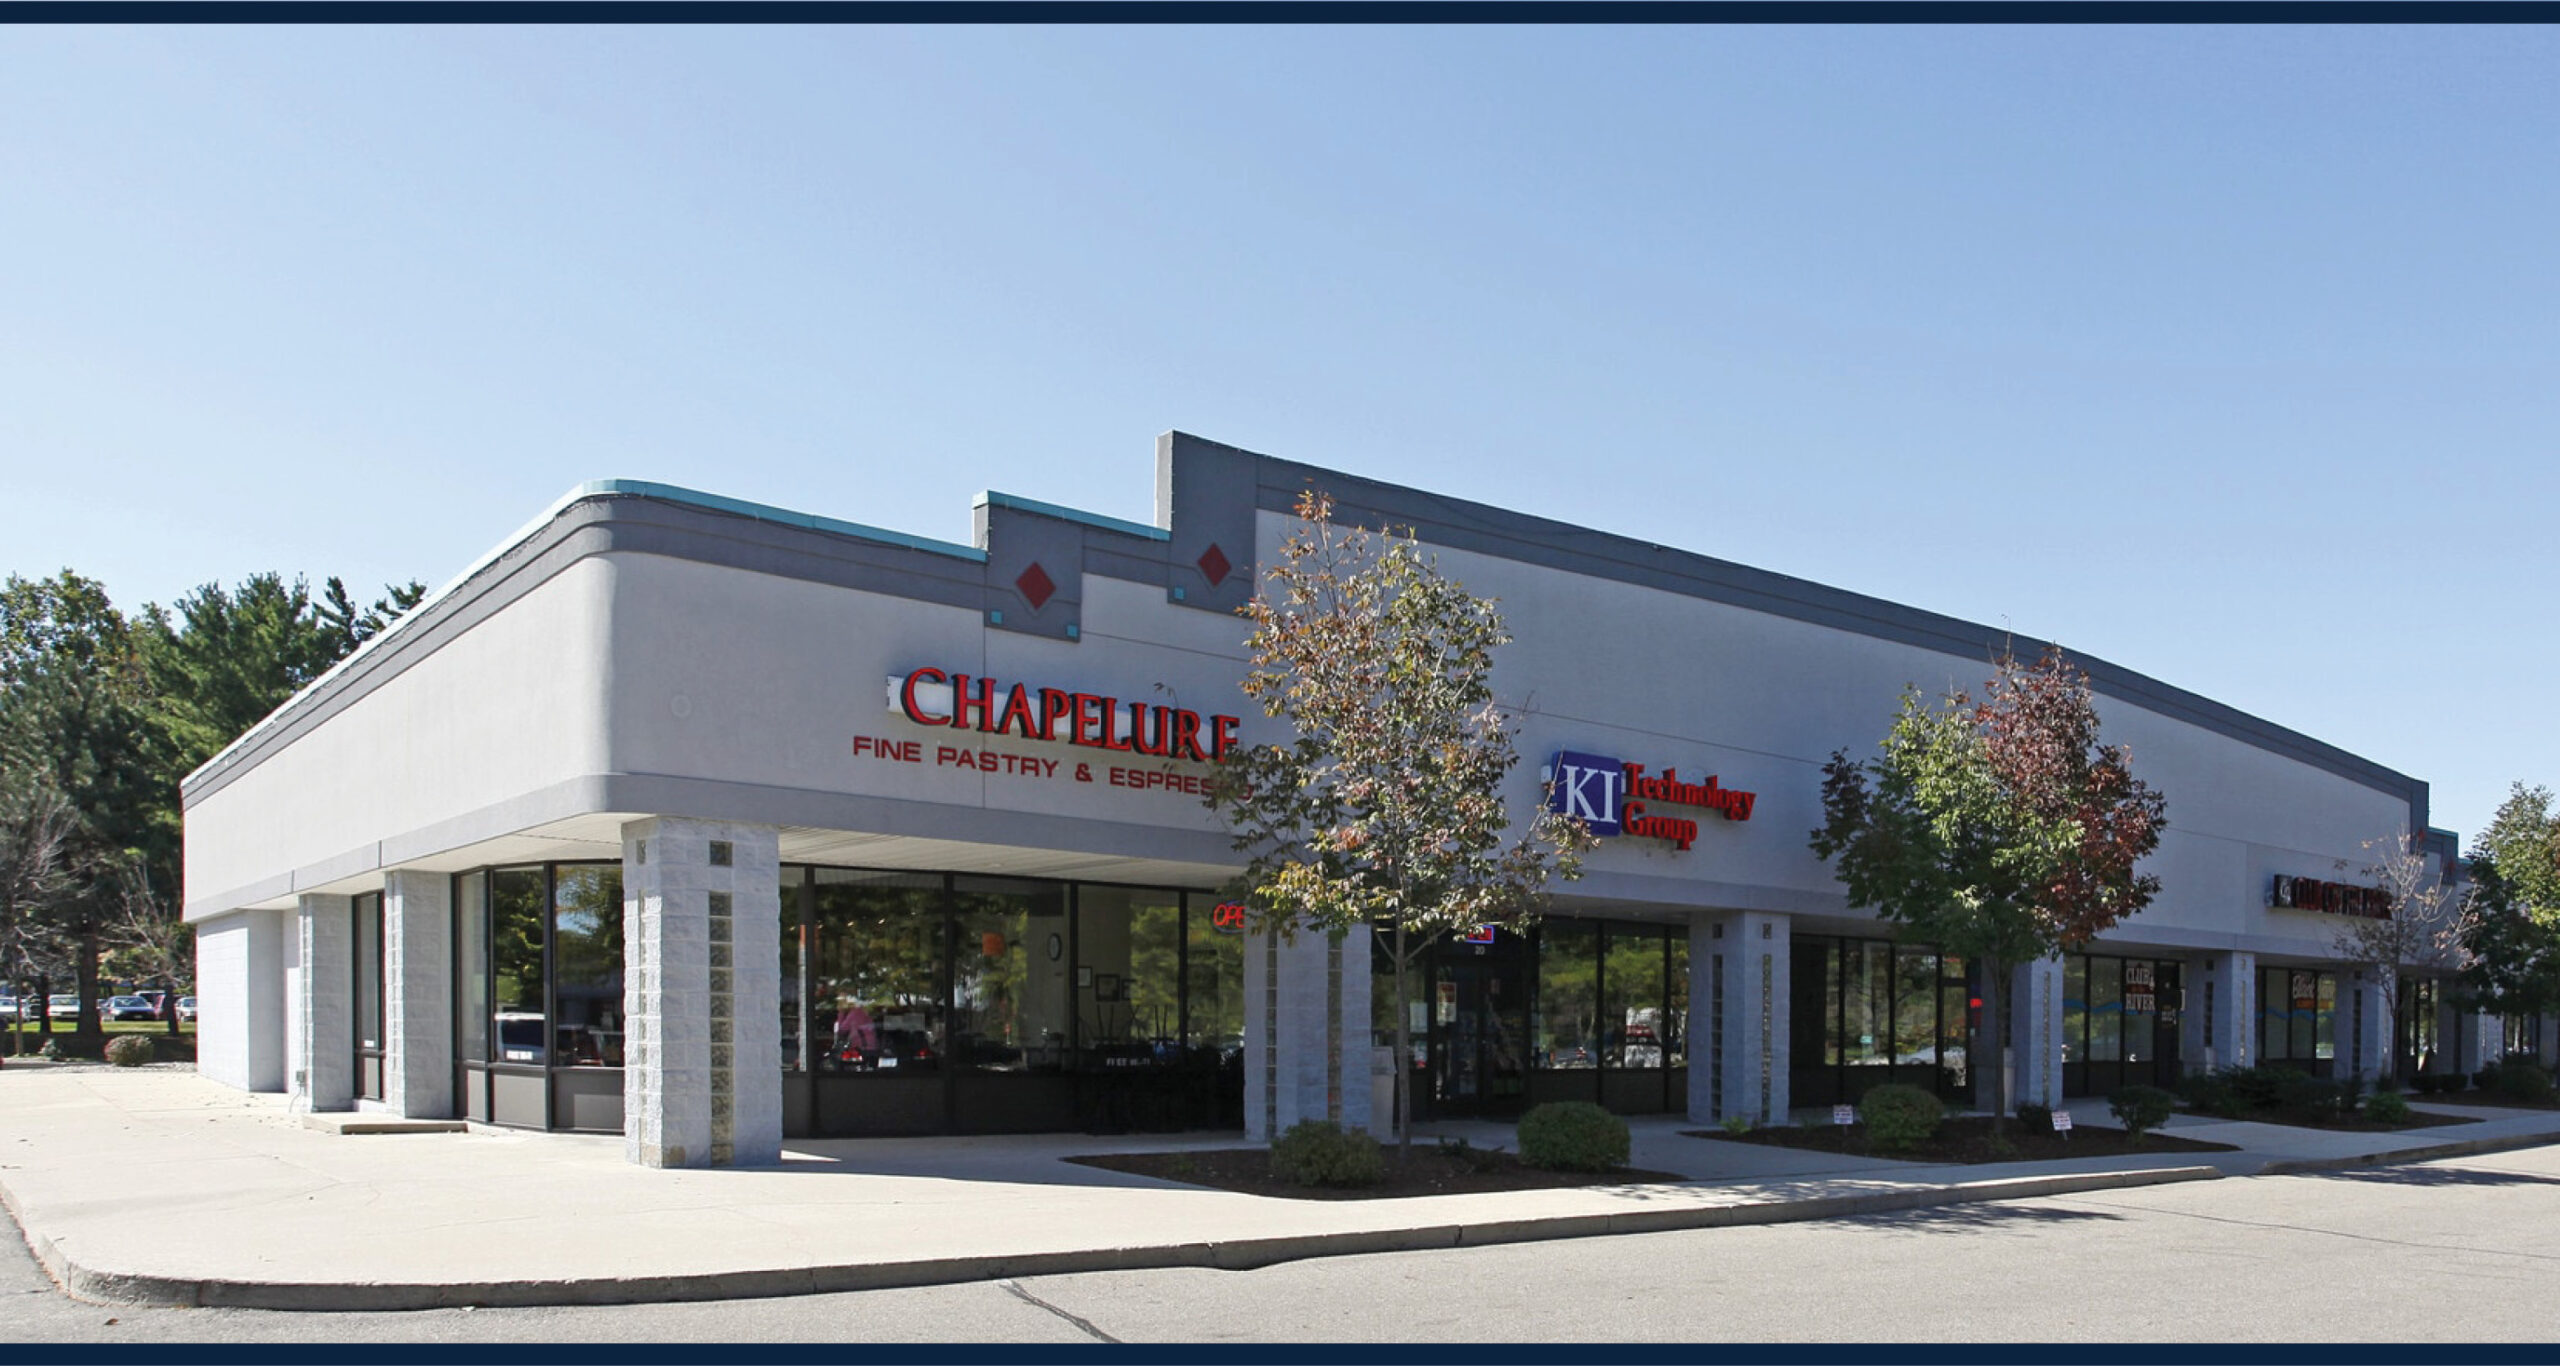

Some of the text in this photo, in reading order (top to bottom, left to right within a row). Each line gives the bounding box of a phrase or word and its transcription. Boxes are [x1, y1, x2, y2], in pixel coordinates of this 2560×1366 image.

[853, 735, 922, 763] FINE
[937, 747, 1059, 780] PASTRY
[1075, 763, 1093, 783] &
[1563, 764, 1617, 823] KI
[1624, 763, 1756, 821] Technology
[1624, 802, 1697, 850] Group
[1214, 904, 1246, 928] OPE
